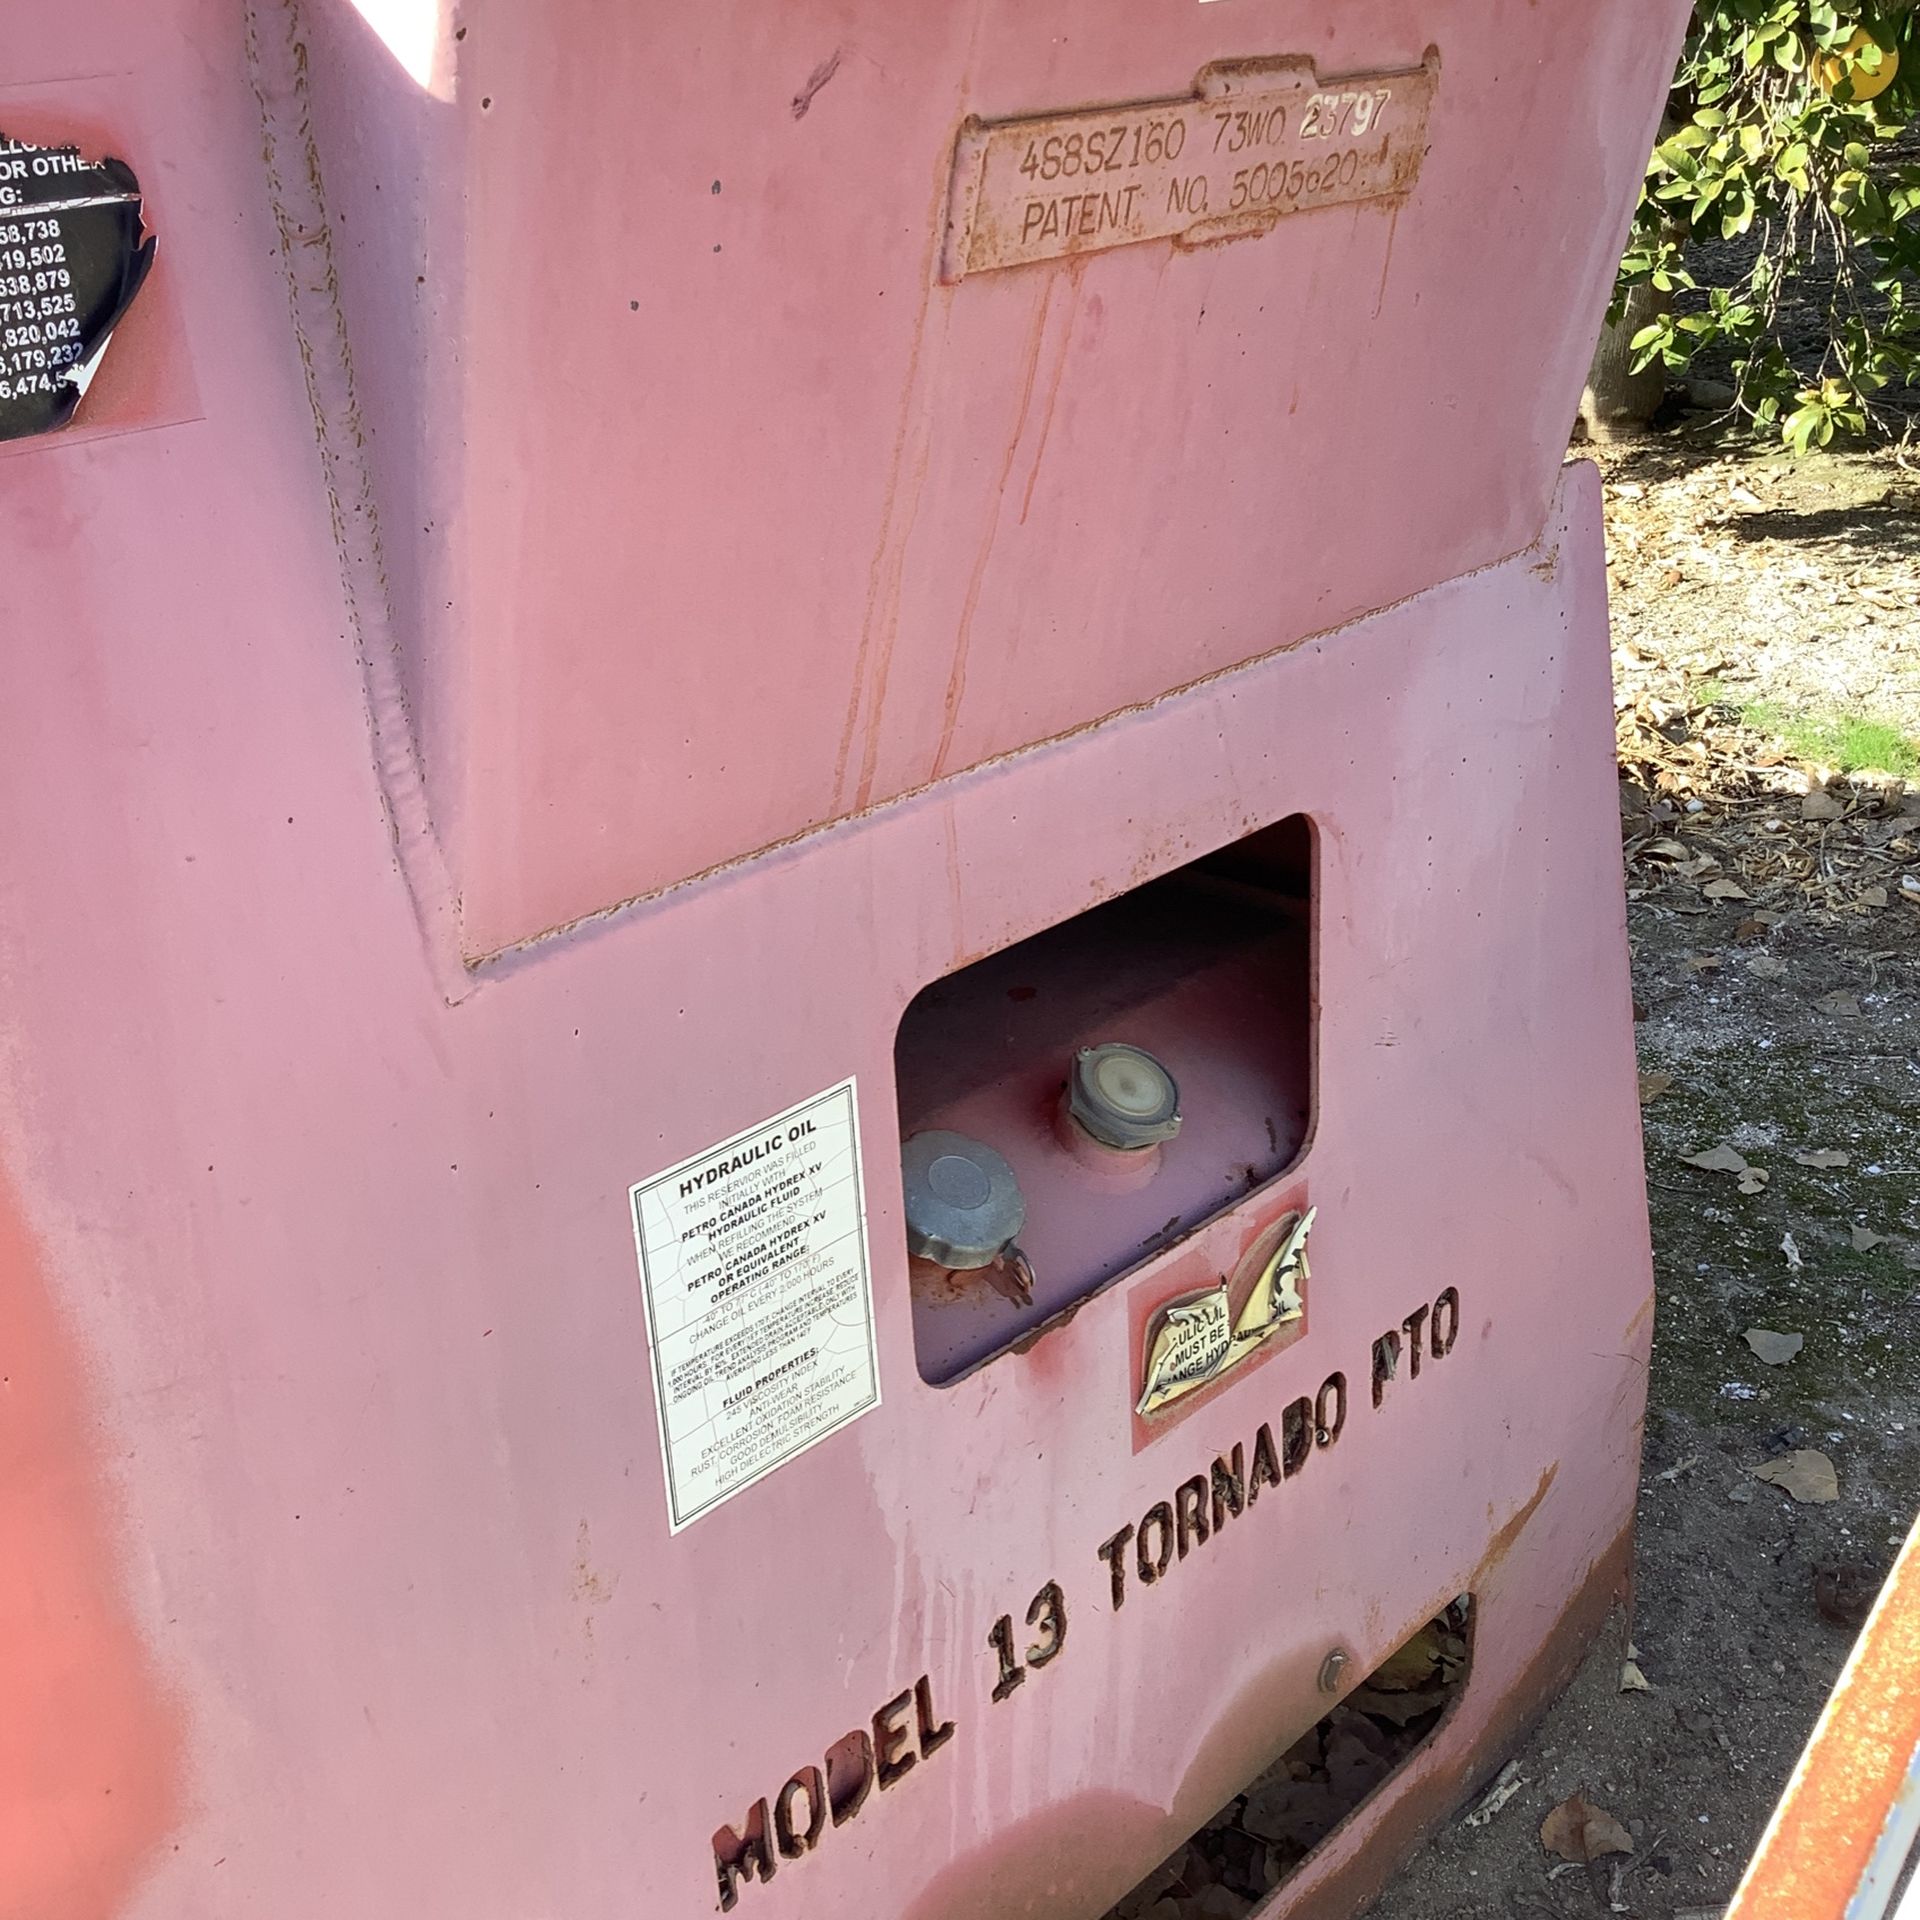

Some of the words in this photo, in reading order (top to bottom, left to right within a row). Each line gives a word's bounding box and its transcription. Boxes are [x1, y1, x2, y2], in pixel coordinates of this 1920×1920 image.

[1299, 88, 1392, 140] 23797
[1021, 183, 1142, 244] PATENT
[0, 244, 66, 270] 19,502
[680, 1135, 782, 1197] HYDRAULIC
[788, 1119, 816, 1141] OIL
[684, 1197, 705, 1214] THIS
[707, 1168, 761, 1202] RESERVIOR
[763, 1157, 784, 1173] WAS
[785, 1140, 816, 1162] FILLED
[681, 1217, 716, 1242] PETRO
[720, 1194, 761, 1221] CANADA
[764, 1170, 805, 1197] HYDREX
[809, 1162, 821, 1174] XV
[708, 1203, 767, 1240] HYDRAULIC
[770, 1186, 799, 1207] FLUID
[718, 1182, 759, 1208] INITIALLY
[762, 1168, 785, 1186] WITH
[686, 1244, 716, 1265] WHEN
[718, 1218, 764, 1249] REFILLING
[766, 1207, 784, 1222] THE
[786, 1187, 822, 1213] SYSTEM
[687, 1267, 721, 1291] PETRO
[725, 1243, 766, 1270] CANADA
[769, 1219, 809, 1246] HYDREX
[813, 1210, 825, 1223] XV
[719, 1246, 732, 1261] WE
[736, 1214, 795, 1250] RECOMMEND
[710, 1266, 768, 1303] OPERATING
[772, 1245, 808, 1269] RANGE:
[718, 1273, 733, 1286] OR
[736, 1236, 798, 1276] EQUIVALENT
[689, 1315, 728, 1343] CHANGE
[730, 1307, 744, 1320] OIL
[747, 1288, 776, 1311] EVERY
[803, 1256, 834, 1279] HOURS
[759, 1305, 802, 1332] TEMPERATURE
[812, 1291, 856, 1320] TEMPERATURES
[678, 1341, 722, 1370] TEMPERATURE
[724, 1324, 753, 1346] EXCEEDS
[726, 1356, 761, 1380] AVERAGING
[1174, 1335, 1207, 1367] MUST
[1210, 1323, 1225, 1344] BE
[722, 1385, 752, 1407] FLUID
[755, 1347, 818, 1388] PROPERTIES:
[743, 1376, 788, 1408] VISCOSITY
[792, 1359, 817, 1380] INDEX
[749, 1382, 798, 1417] ANTI-WEAR
[777, 1403, 802, 1423] FOAM
[804, 1369, 855, 1405] RESISTANCE
[701, 1421, 752, 1458] EXCELLENT
[755, 1391, 802, 1425] OXIDATION
[804, 1365, 844, 1395] STABILITY
[730, 1442, 757, 1464] GOOD
[759, 1402, 822, 1447] DEMULSIBILITY
[715, 1466, 737, 1485] HIGH
[740, 1433, 790, 1470] DIELECTRIC
[793, 1404, 839, 1437] STRENGTH
[711, 1673, 956, 1914] MODEL
[987, 1579, 1067, 1704] 13
[1097, 1370, 1347, 1612] TORNADO
[1370, 1286, 1460, 1408] PTO
